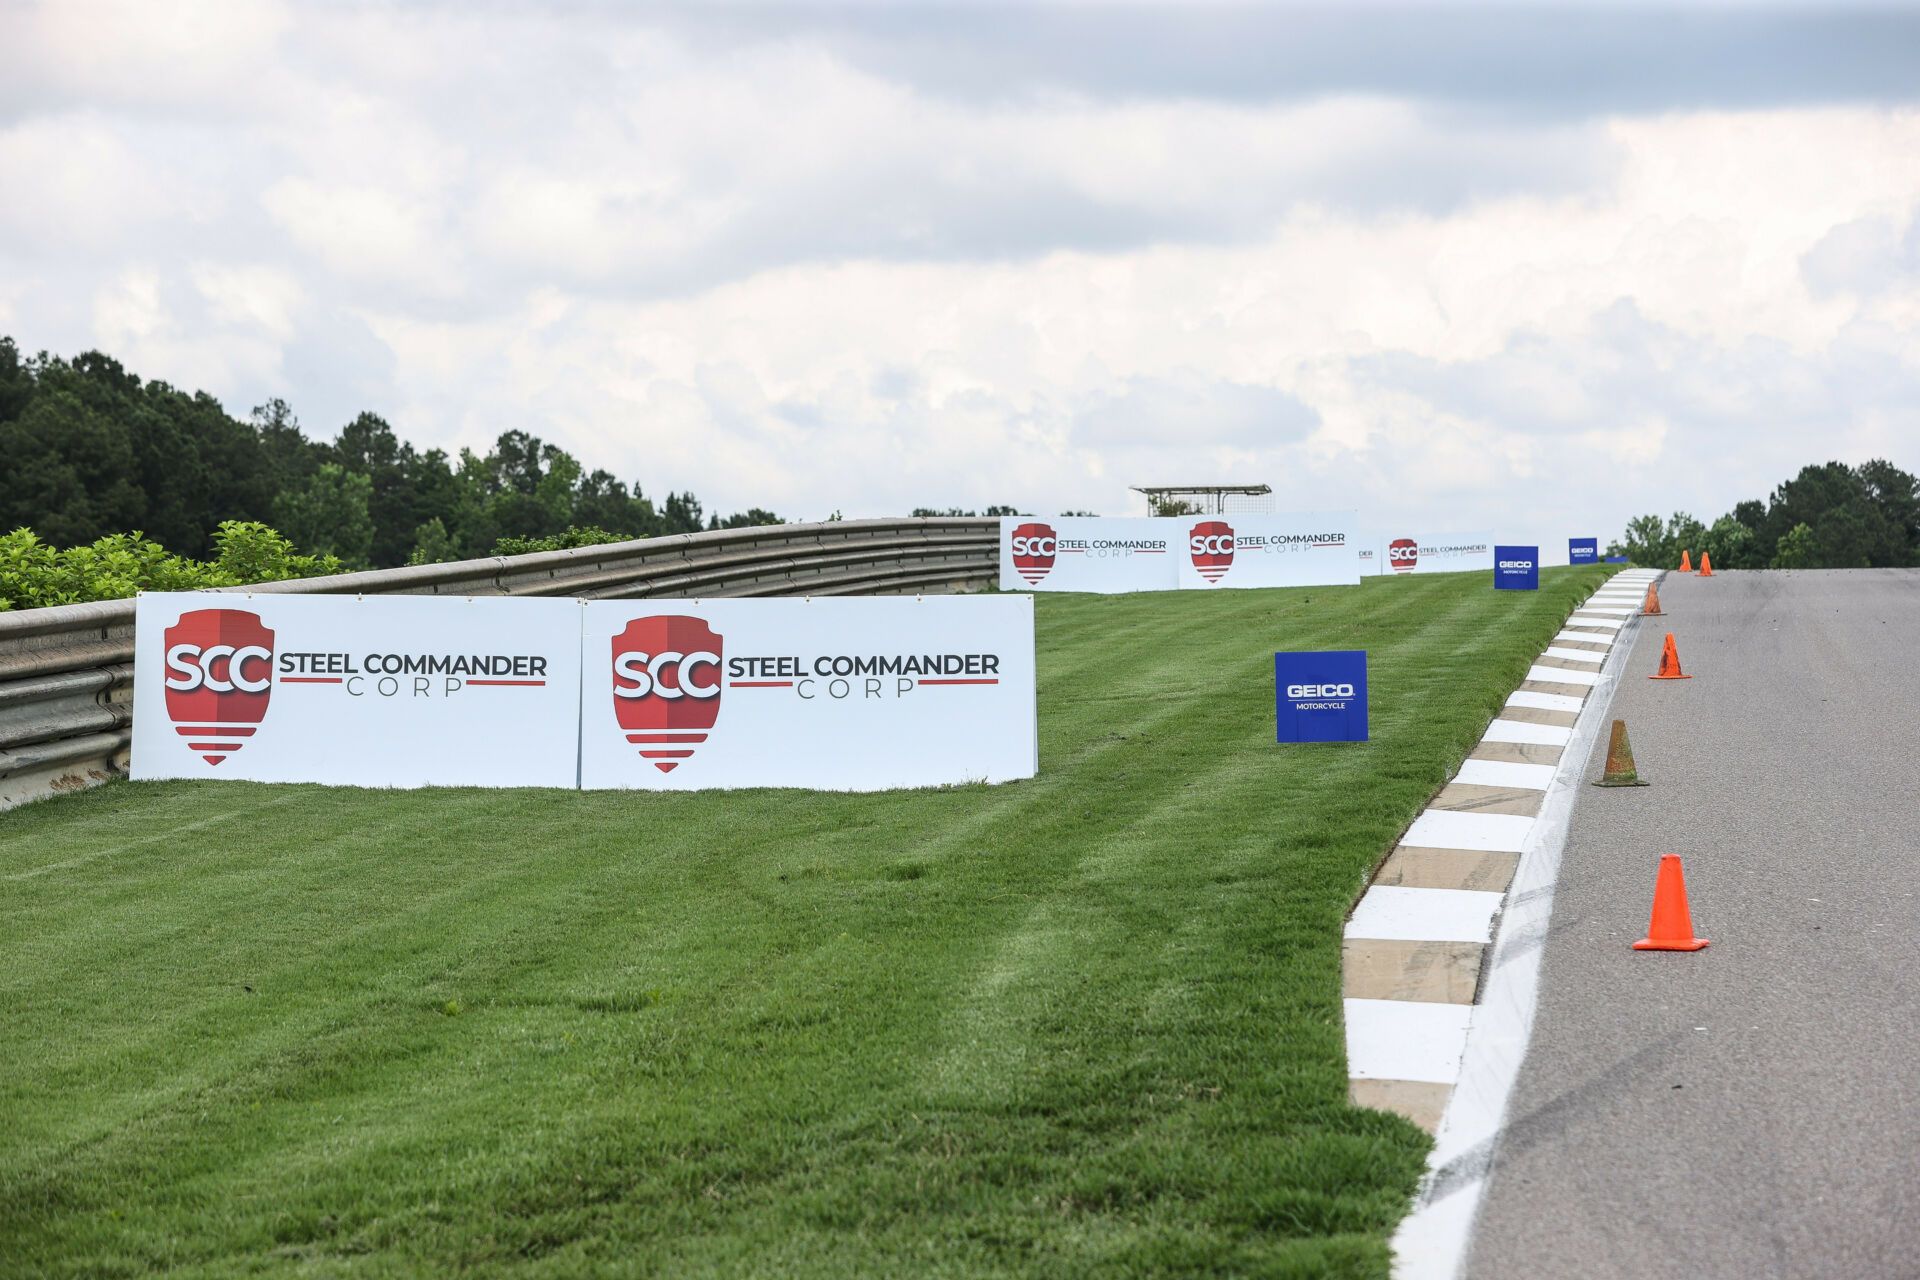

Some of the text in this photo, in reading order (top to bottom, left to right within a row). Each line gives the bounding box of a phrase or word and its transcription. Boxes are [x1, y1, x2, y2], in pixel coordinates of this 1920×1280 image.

[1012, 536, 1056, 557] SCC
[1058, 539, 1167, 549] STEEL COMMANDER
[1190, 534, 1234, 556] SCC
[1236, 533, 1345, 546] STEEL COMMANDER
[1085, 549, 1133, 558] CORP
[1263, 543, 1313, 554] CORP
[1390, 546, 1417, 561] SCC
[1440, 544, 1487, 553] COMMANDER
[1499, 560, 1532, 569] GEICO
[165, 643, 272, 693] SCC
[279, 652, 547, 677] STEEL COMMANDER
[728, 654, 1000, 678] STEEL COMMANDER
[613, 650, 721, 699] SCC
[346, 676, 462, 698] CORP
[797, 678, 915, 700] CORP
[1287, 683, 1354, 698] GEICO
[1296, 702, 1346, 710] MOTORCYCLE
